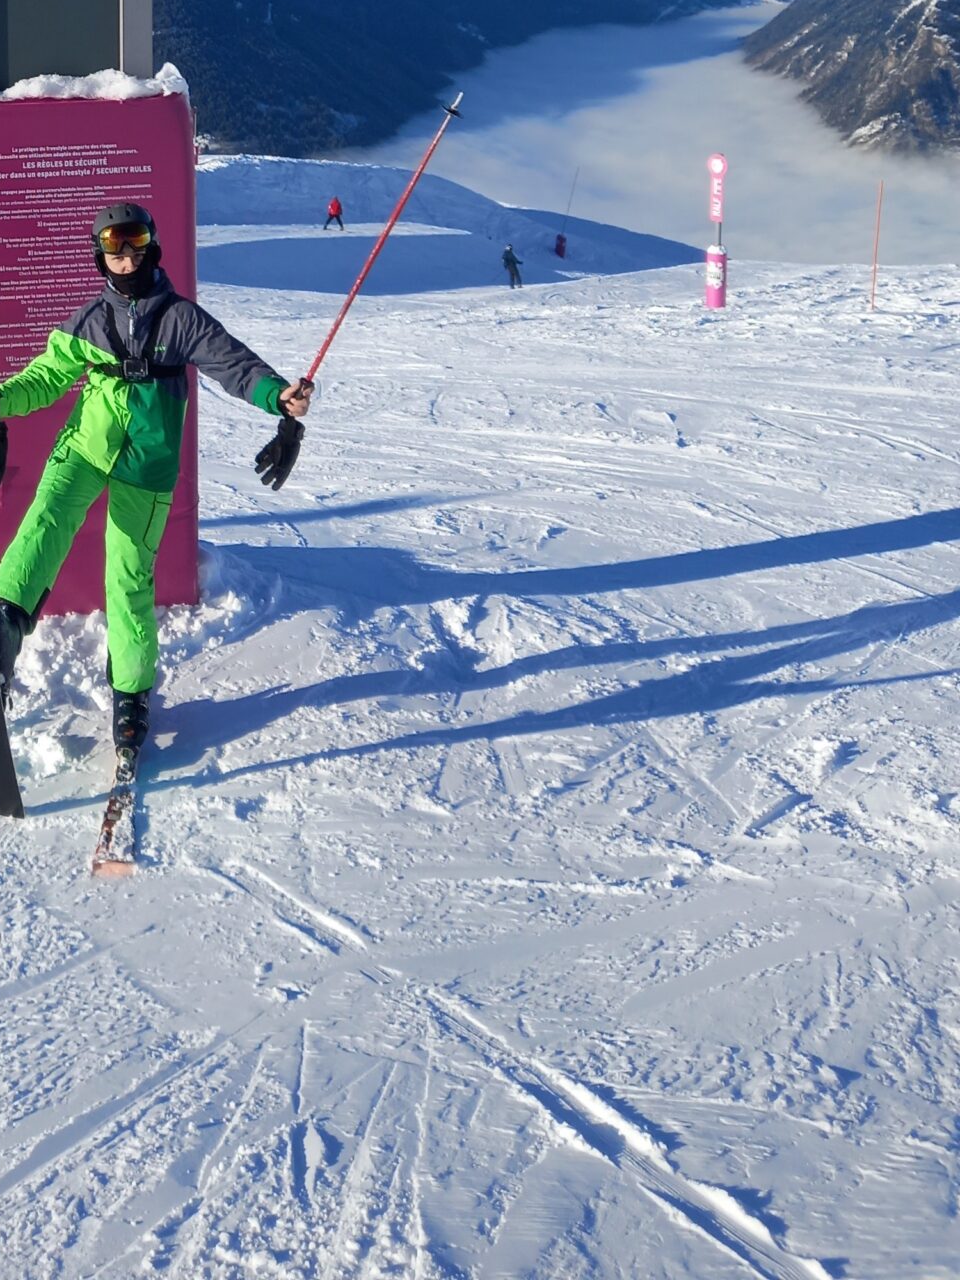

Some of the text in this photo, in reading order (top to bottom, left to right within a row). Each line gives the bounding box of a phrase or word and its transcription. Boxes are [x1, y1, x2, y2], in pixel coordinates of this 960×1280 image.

[9, 171, 26, 179] dans
[37, 171, 60, 179] espace
[61, 168, 91, 177] freestyle
[96, 167, 129, 175] SECURITY
